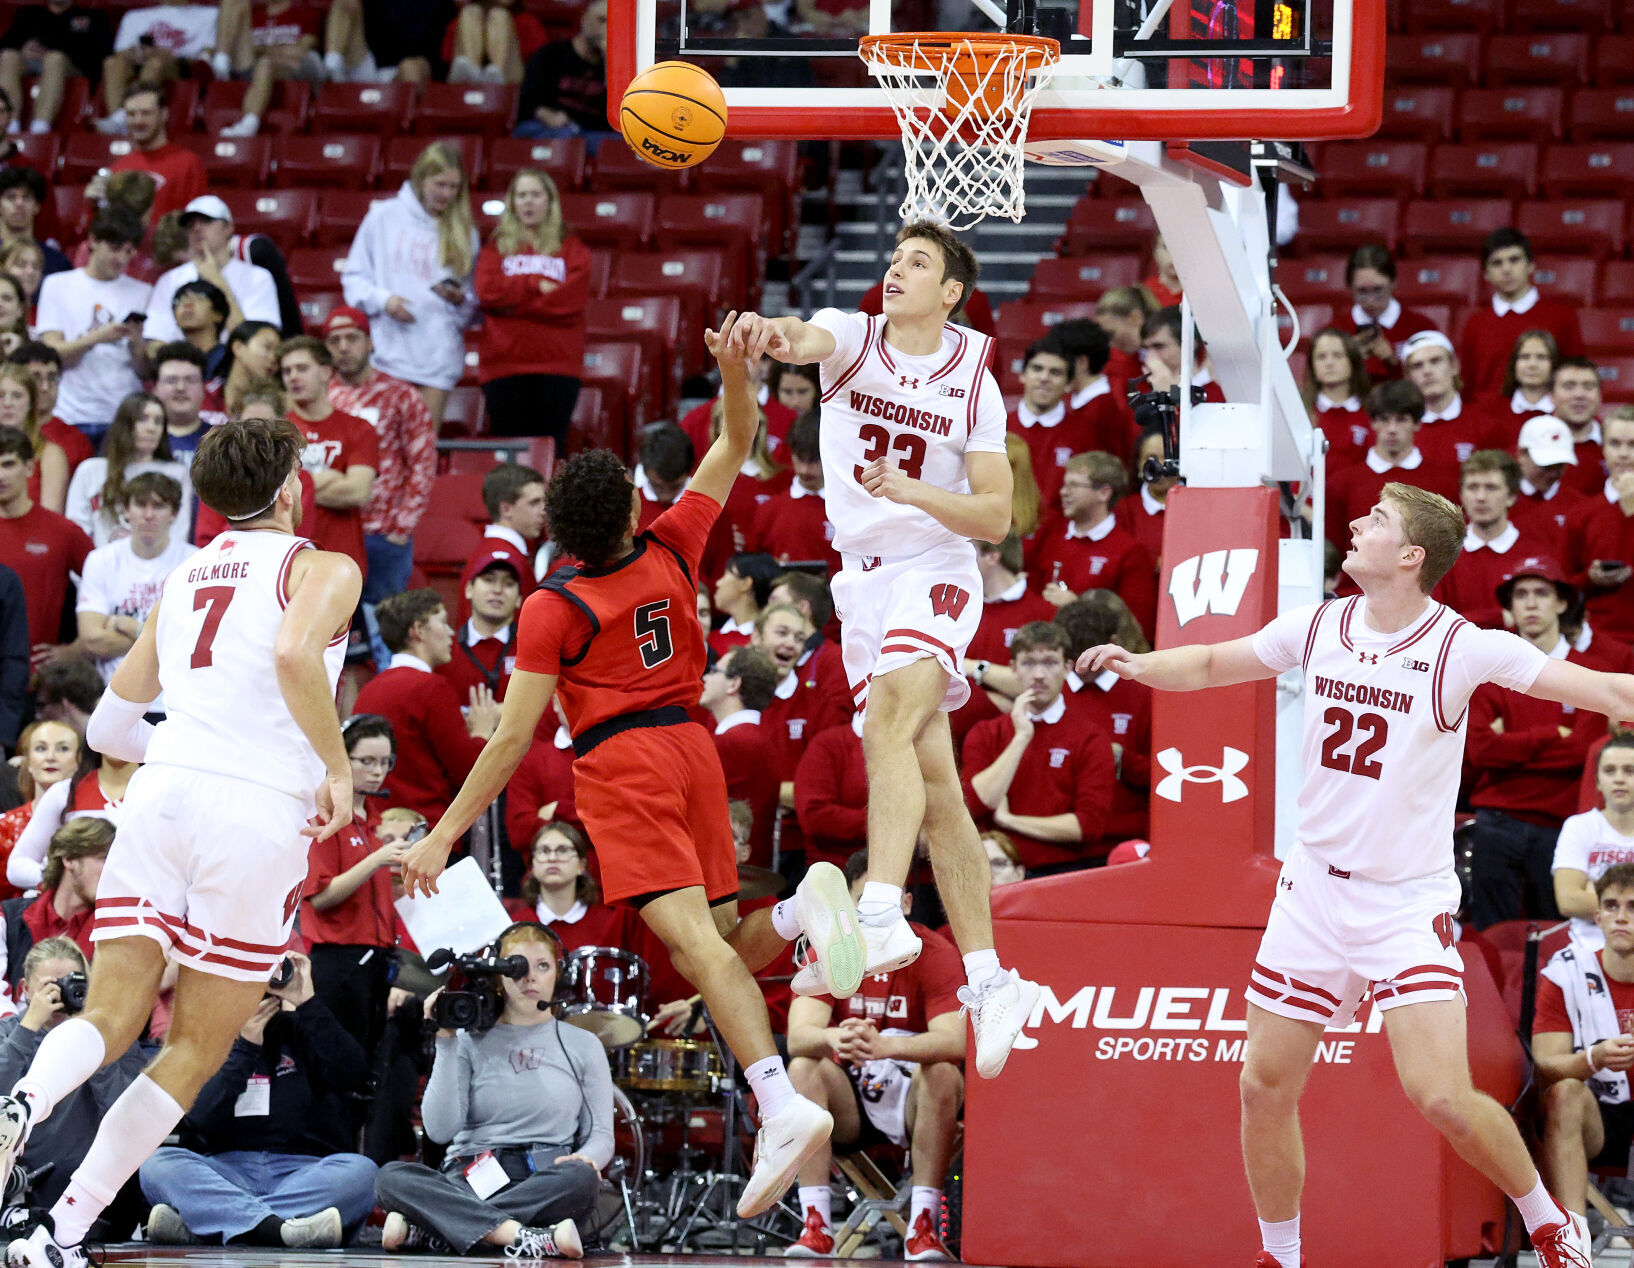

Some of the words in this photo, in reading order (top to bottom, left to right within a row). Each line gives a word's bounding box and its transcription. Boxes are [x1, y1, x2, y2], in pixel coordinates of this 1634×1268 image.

[641, 137, 692, 163] NCAA
[850, 389, 954, 437] WISCONSIN
[853, 423, 928, 486] 33
[187, 561, 250, 583] GILMORE
[190, 585, 236, 670] 7
[633, 598, 674, 670] 5
[1314, 675, 1414, 715] WISCONSIN
[1320, 706, 1388, 781] 22
[1022, 985, 1384, 1034] MUEL
[1095, 1036, 1210, 1062] SPORTS
